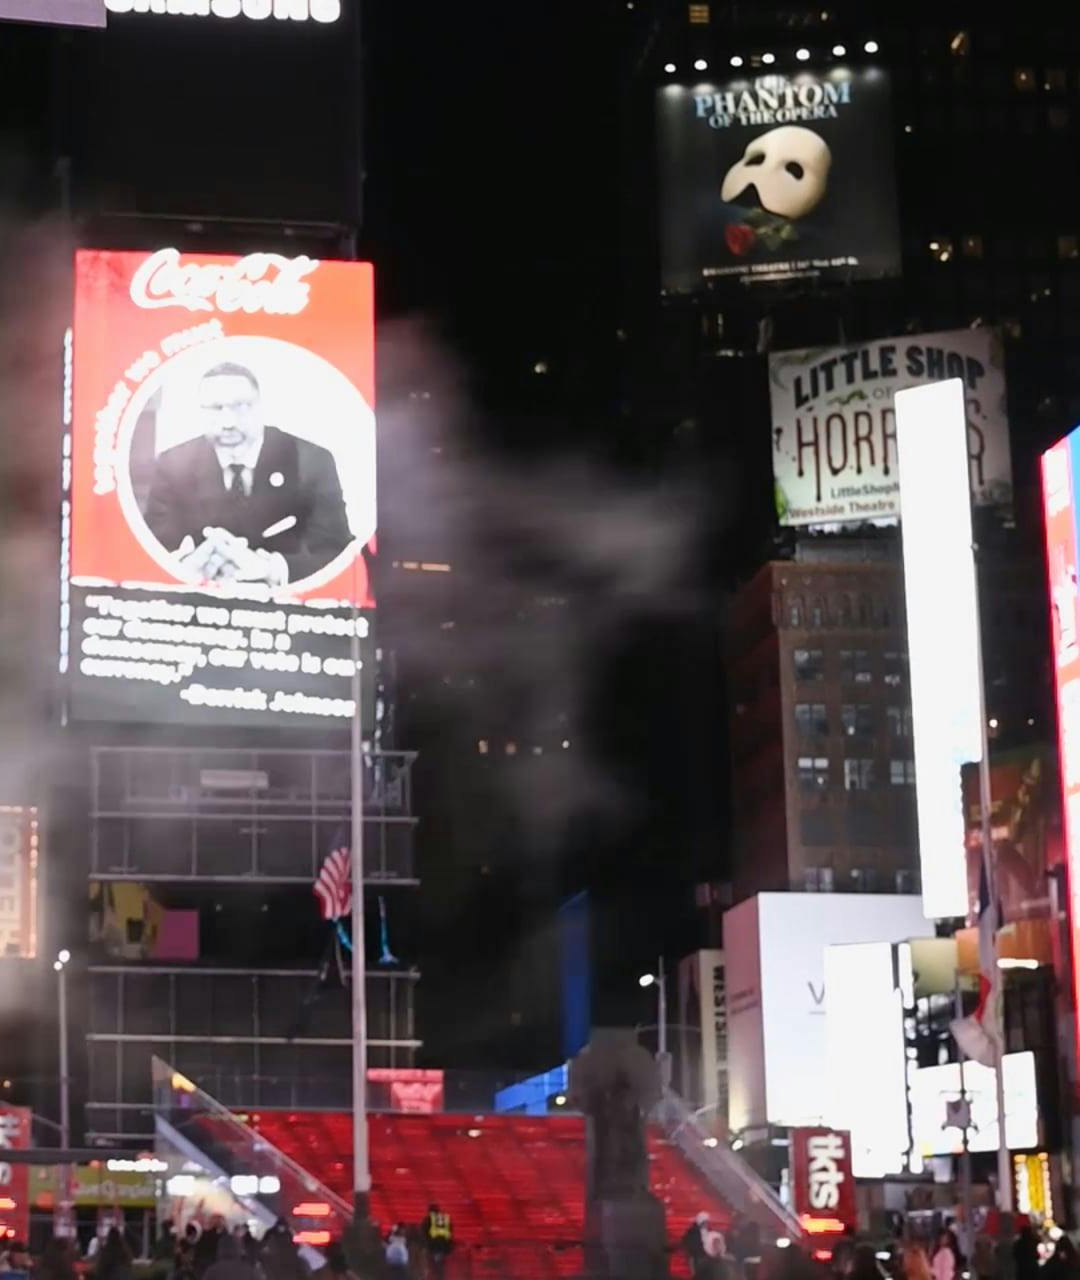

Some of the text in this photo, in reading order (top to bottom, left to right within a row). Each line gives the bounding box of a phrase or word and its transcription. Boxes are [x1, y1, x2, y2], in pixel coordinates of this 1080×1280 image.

[694, 81, 851, 118] PHANTOM
[709, 103, 838, 130] OF THE OPERA
[794, 345, 986, 410] LITTLE SHOP
[807, 1133, 845, 1209] tkts
